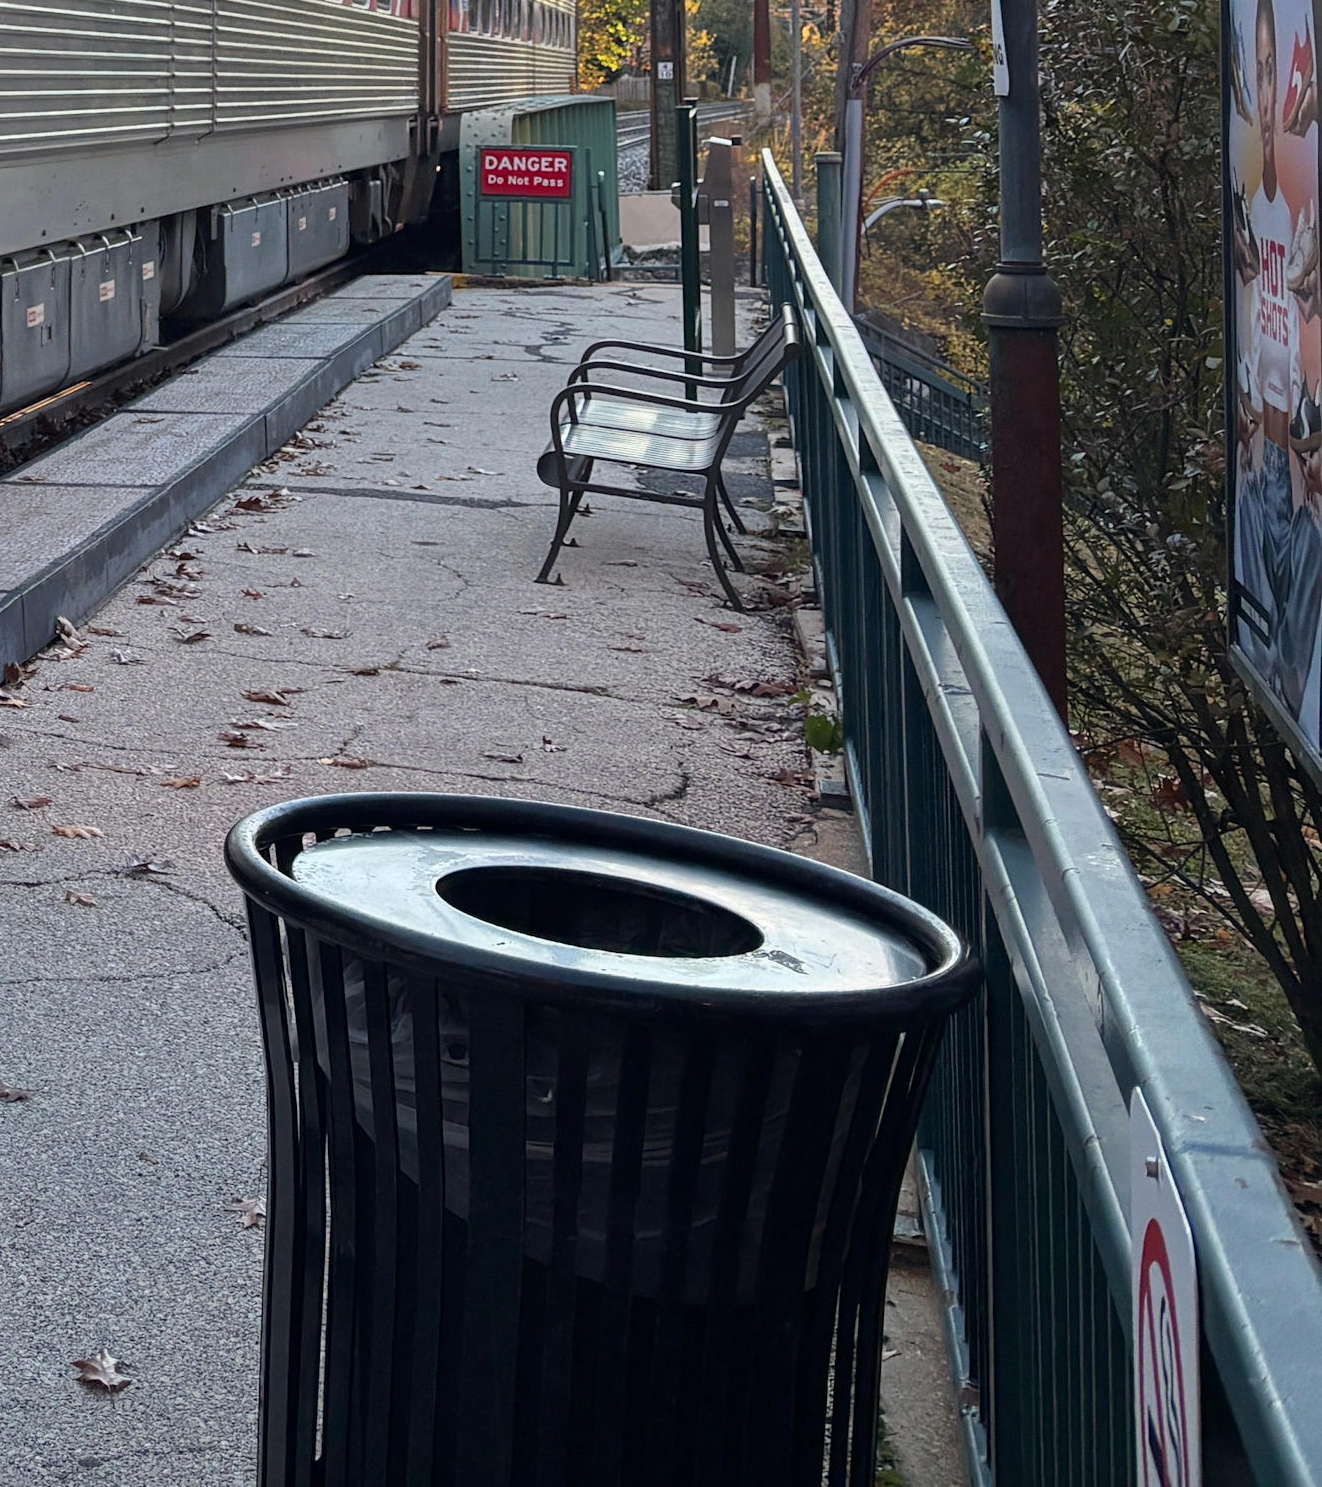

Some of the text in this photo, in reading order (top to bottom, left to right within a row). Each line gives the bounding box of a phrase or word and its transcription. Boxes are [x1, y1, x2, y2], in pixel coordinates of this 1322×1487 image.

[485, 155, 567, 173] DANGER
[488, 174, 564, 187] Do Not Pass
[1260, 237, 1287, 301] HOT
[1260, 298, 1289, 347] SHOTS
